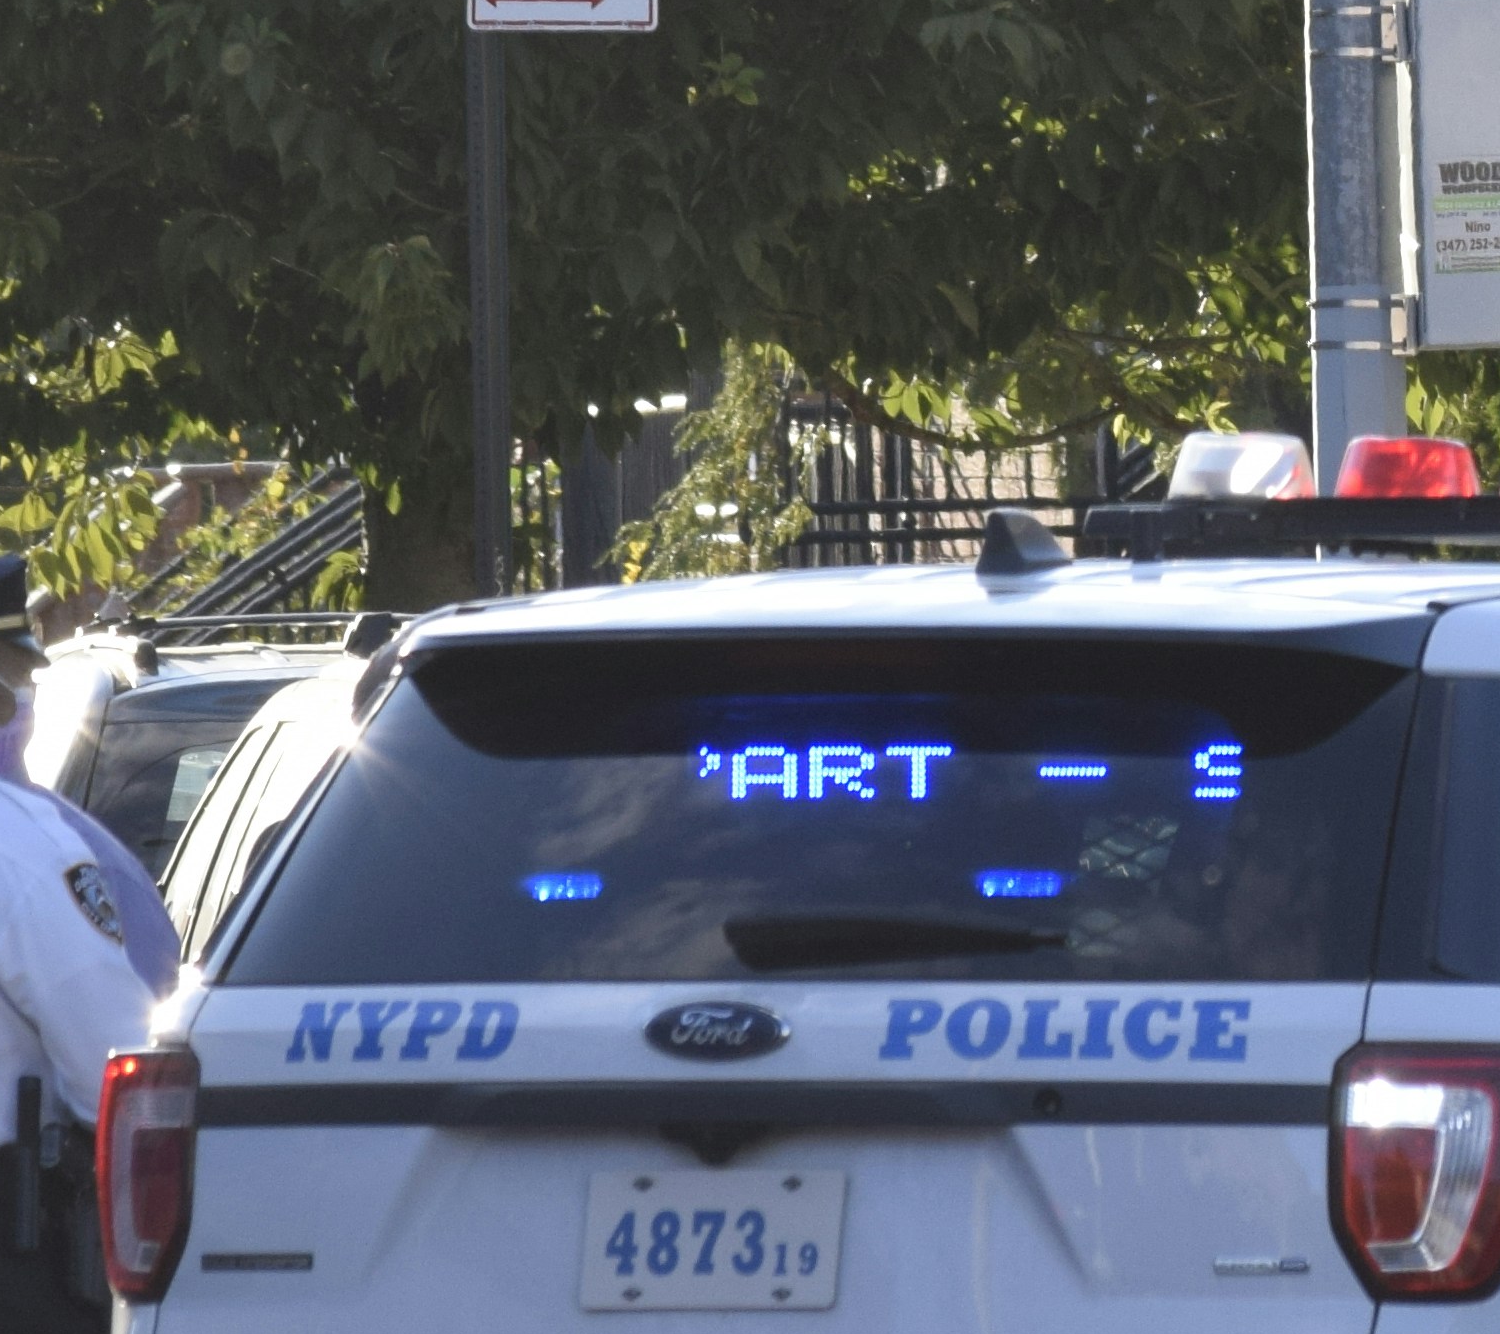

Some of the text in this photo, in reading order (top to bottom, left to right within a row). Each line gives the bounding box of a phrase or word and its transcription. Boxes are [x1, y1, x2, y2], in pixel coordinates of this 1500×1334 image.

[1436, 239, 1467, 253] (347)
[285, 1000, 519, 1064] NYPD
[670, 1007, 753, 1046] Ford
[879, 998, 1251, 1064] POLICE
[605, 1209, 819, 1276] 4873 19
